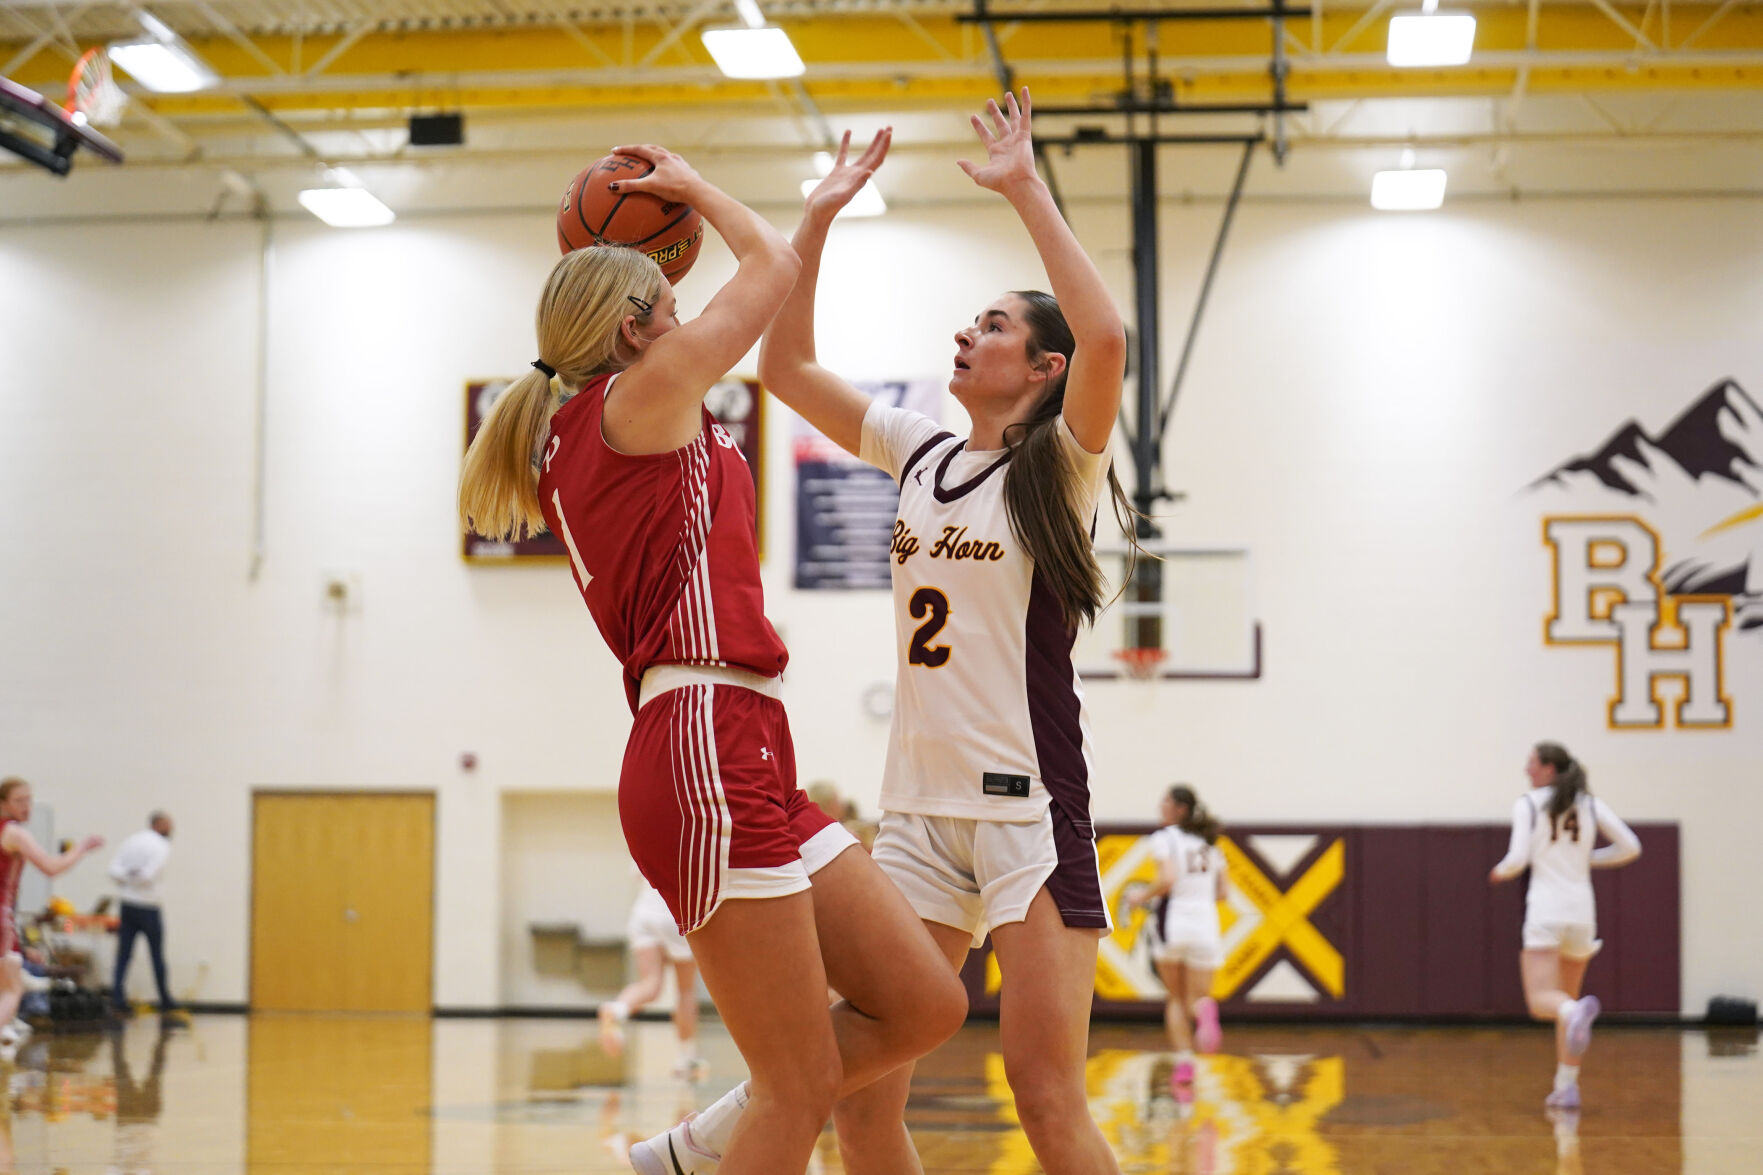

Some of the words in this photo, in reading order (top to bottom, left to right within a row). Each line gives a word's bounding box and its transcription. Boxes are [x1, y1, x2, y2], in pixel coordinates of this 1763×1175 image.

[929, 526, 1005, 561] Horn
[908, 585, 952, 669] 2
[1015, 781, 1022, 790] S
[1549, 807, 1580, 843] 14
